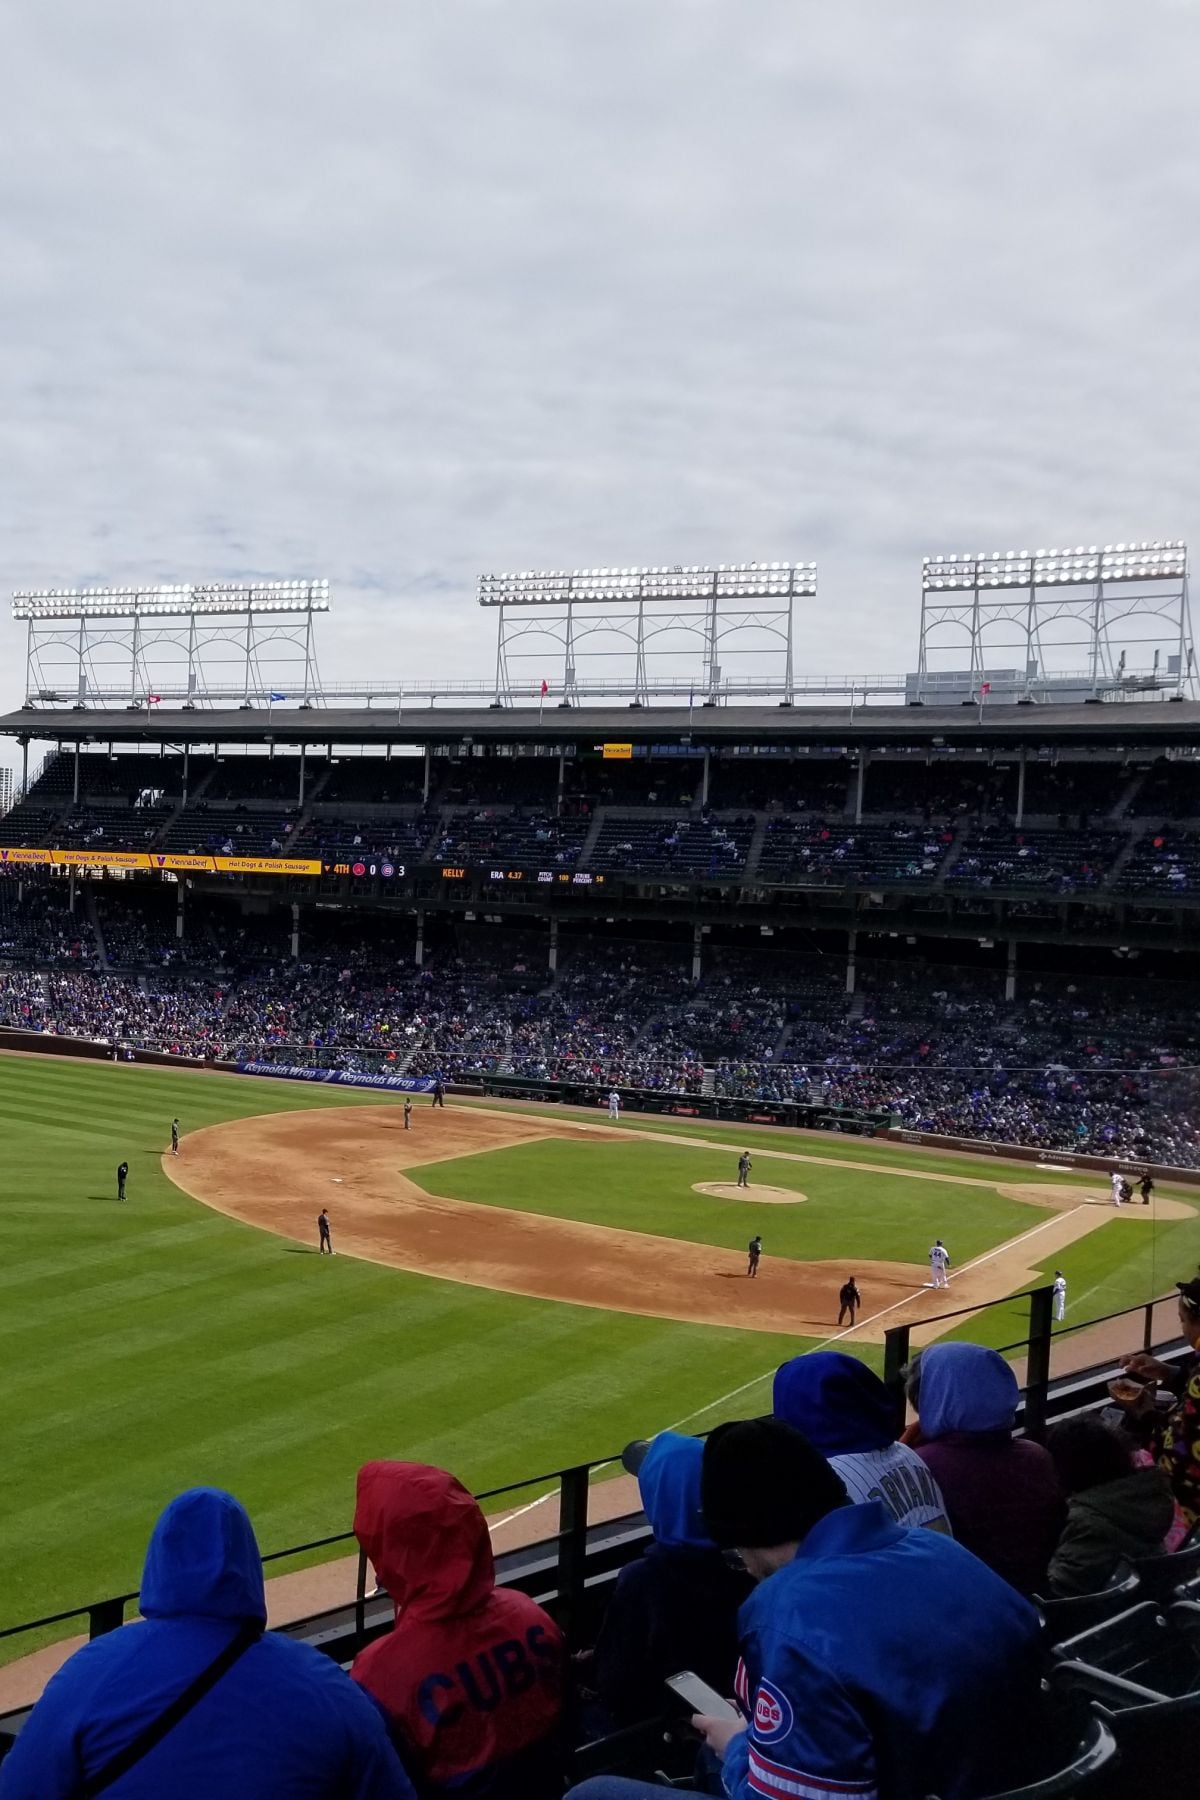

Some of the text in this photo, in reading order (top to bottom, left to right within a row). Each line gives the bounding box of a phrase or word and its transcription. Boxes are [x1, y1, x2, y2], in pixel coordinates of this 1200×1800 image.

[115, 856, 138, 864] Sausage
[170, 858, 207, 868] Vienna Beef
[242, 861, 256, 870] Dogs
[284, 863, 310, 871] Sausage
[333, 864, 405, 876] 4TH 0 3
[442, 869, 464, 877] KELLY
[491, 871, 503, 879] ERA
[244, 1063, 288, 1075] Reynolds
[289, 1066, 316, 1079] Wrap
[339, 1072, 386, 1085] Reynolds
[386, 1077, 416, 1088] Wrap
[417, 1625, 555, 1728] CUBS
